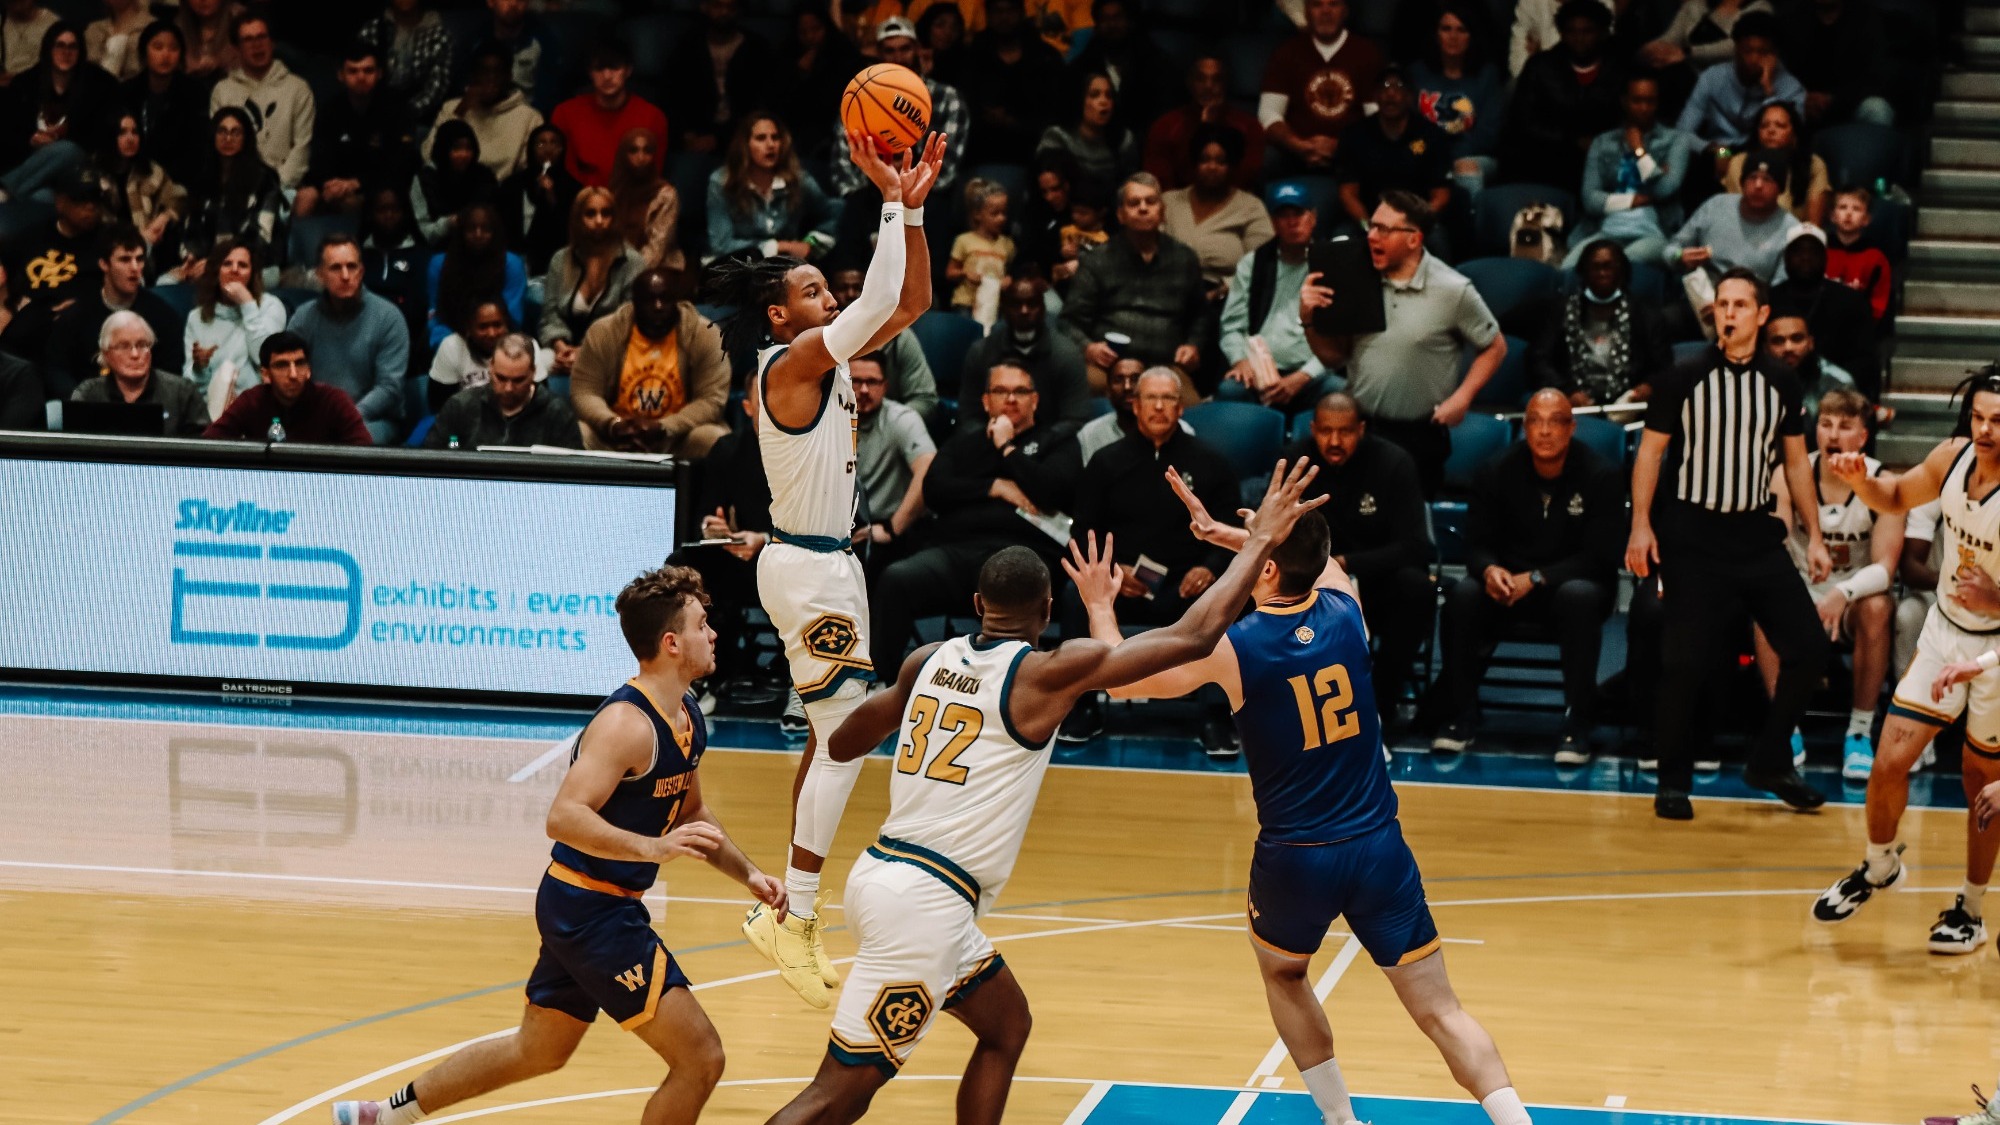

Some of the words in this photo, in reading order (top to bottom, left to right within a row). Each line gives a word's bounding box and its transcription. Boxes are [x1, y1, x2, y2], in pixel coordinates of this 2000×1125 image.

[175, 498, 290, 534] Skyline
[374, 581, 498, 612] exhibits
[529, 591, 618, 617] event
[372, 617, 586, 651] environments
[222, 683, 293, 694] DAKTRONICS
[930, 667, 983, 695] NGANDU
[1286, 663, 1360, 751] 12
[897, 693, 984, 786] 32
[614, 963, 646, 992] W
